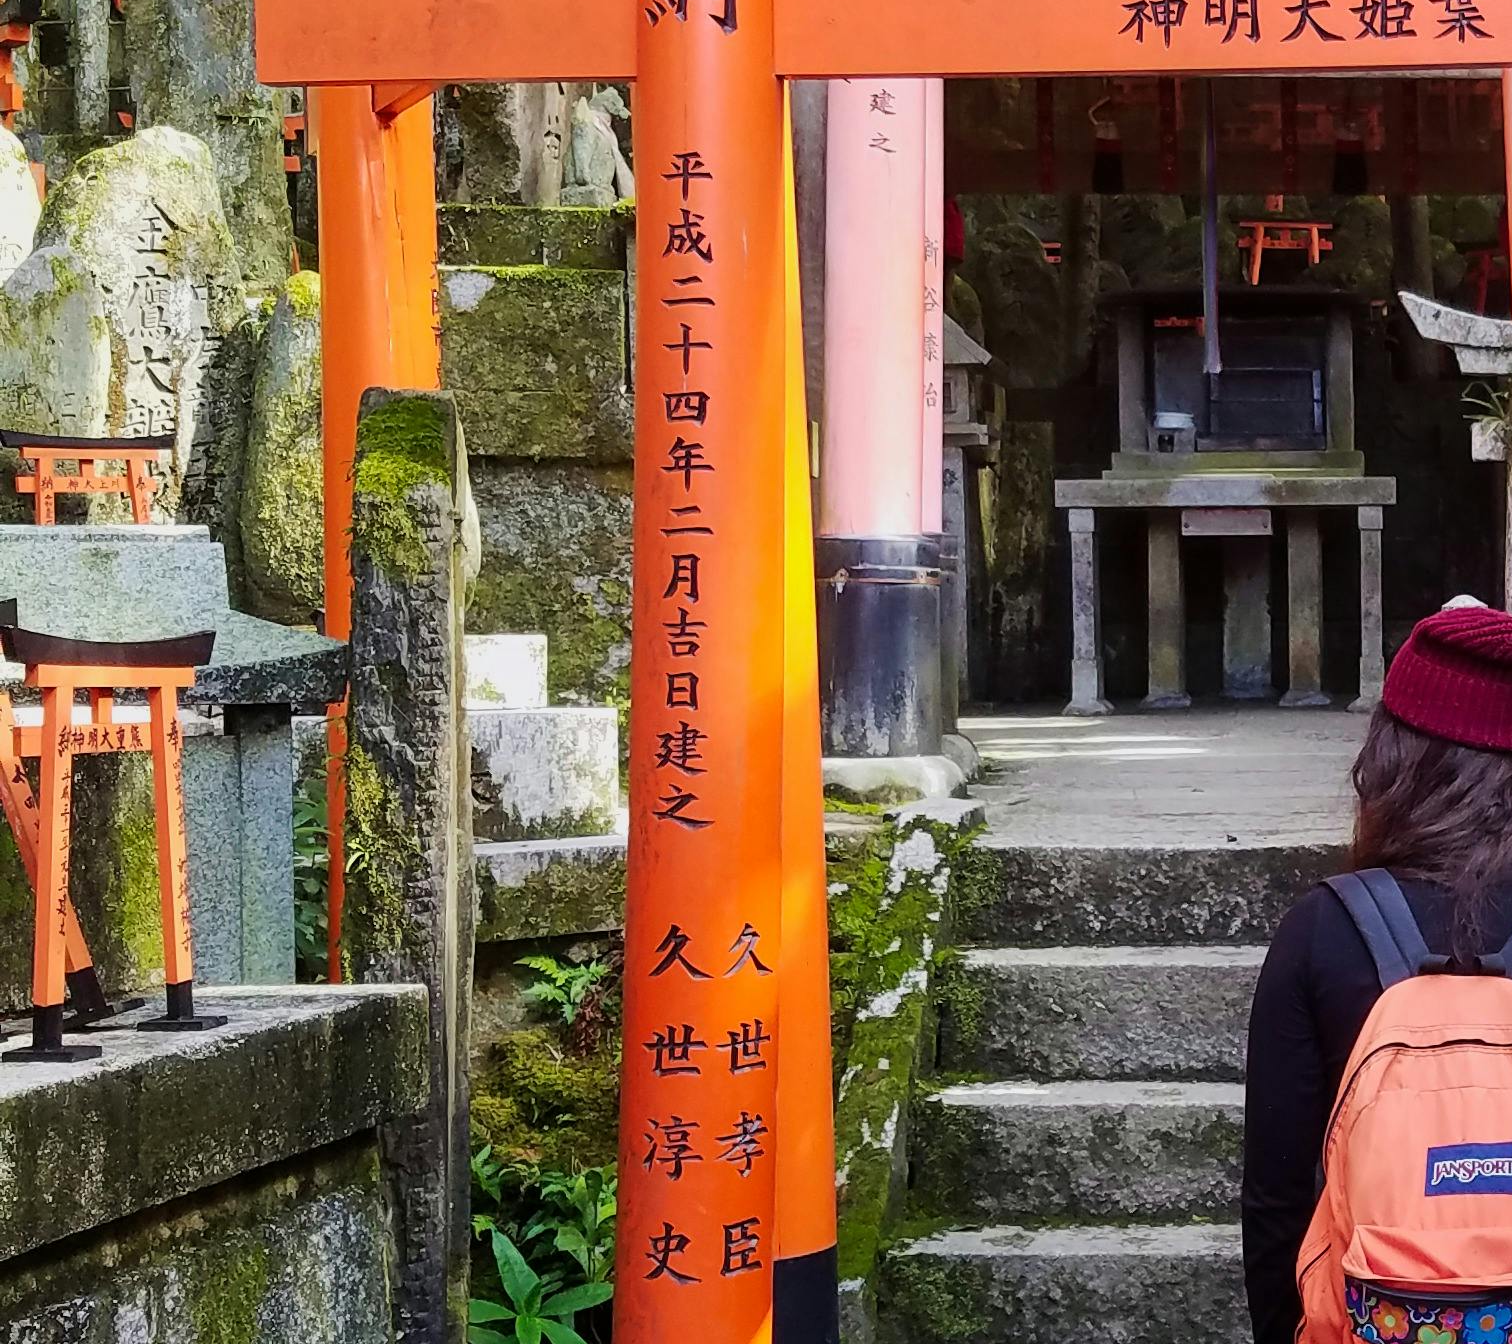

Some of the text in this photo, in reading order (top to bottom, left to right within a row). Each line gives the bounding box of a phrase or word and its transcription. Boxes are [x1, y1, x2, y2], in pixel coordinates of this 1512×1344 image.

[652, 151, 715, 830] 平成二十四年二月吉日建之
[642, 923, 714, 1284] 久世淳史
[715, 922, 774, 1276] 久世孝臣
